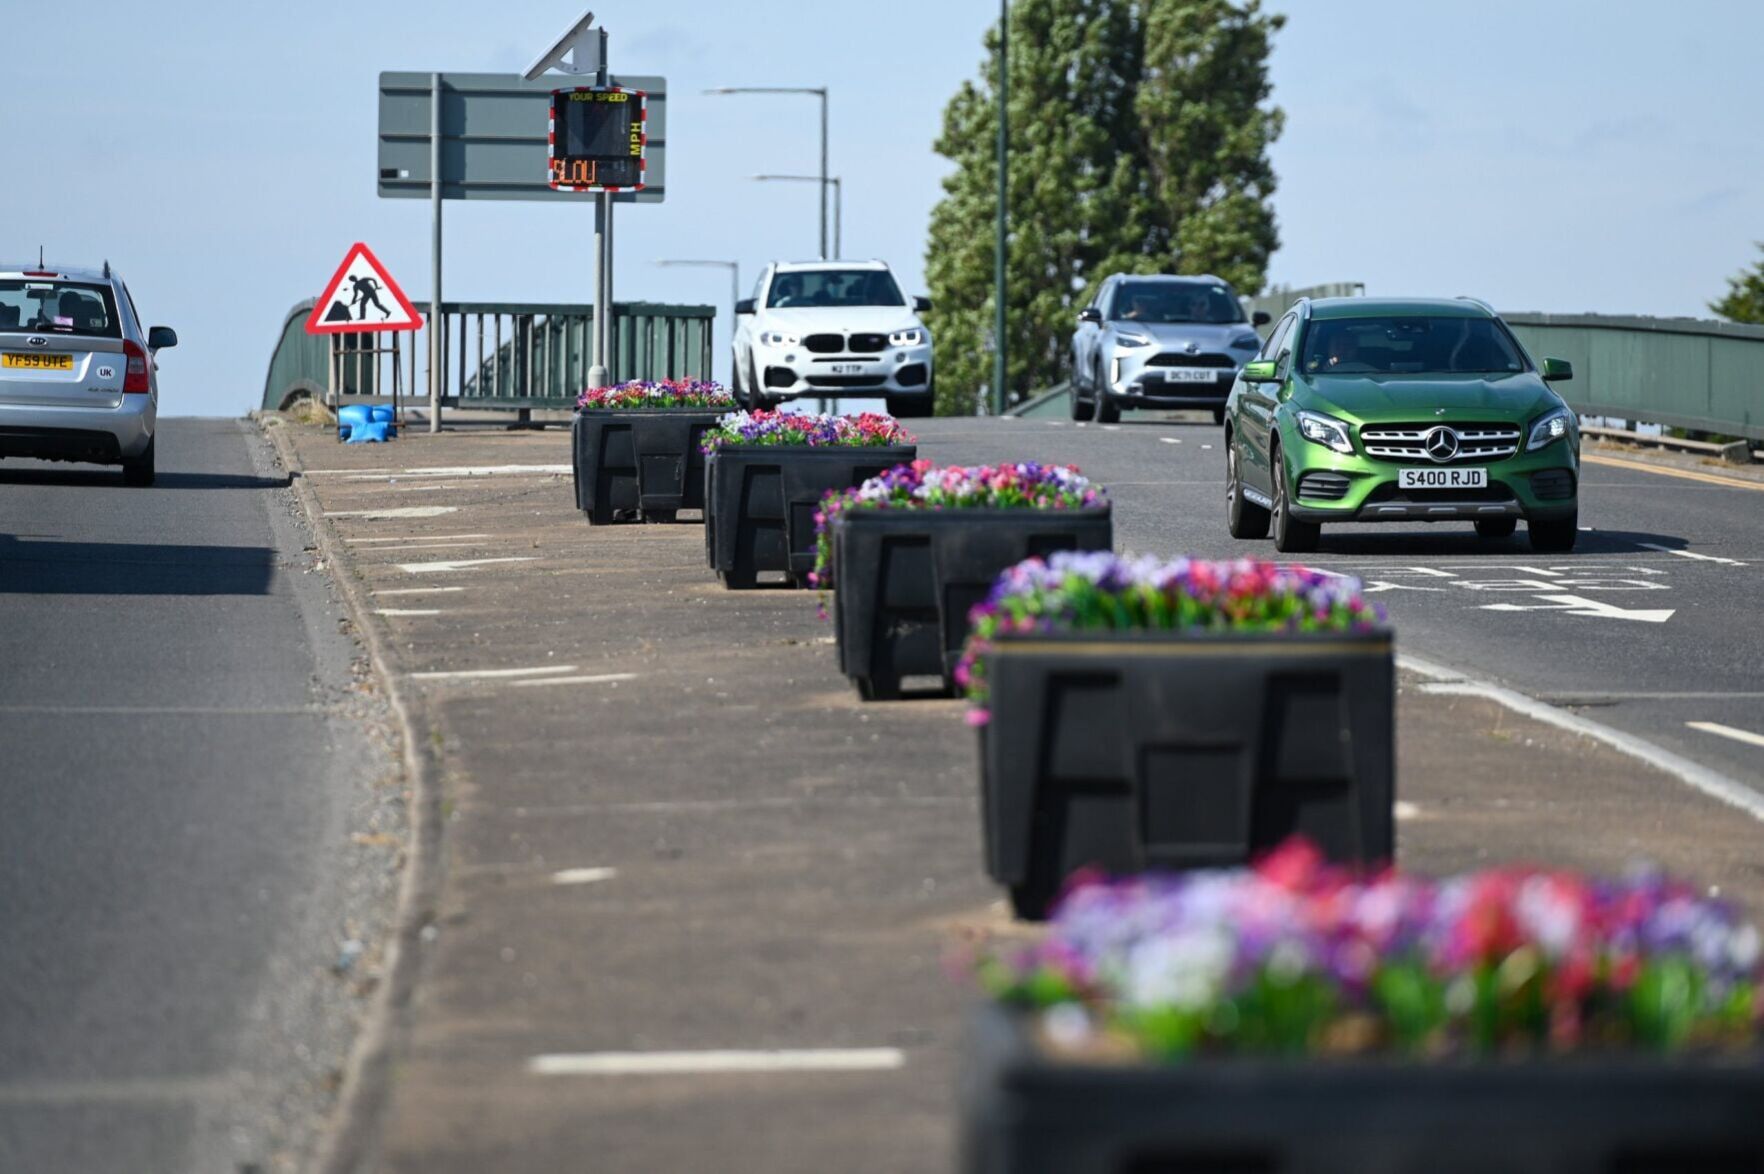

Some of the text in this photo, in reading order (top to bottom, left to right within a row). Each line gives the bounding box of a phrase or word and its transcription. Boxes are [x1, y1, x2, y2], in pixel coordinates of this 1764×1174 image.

[569, 92, 628, 102] YOUR SPEED
[630, 122, 641, 156] MPH
[7, 353, 67, 368] YF59 UTE
[99, 368, 112, 377] UK
[1406, 471, 1481, 486] S400 RJD
